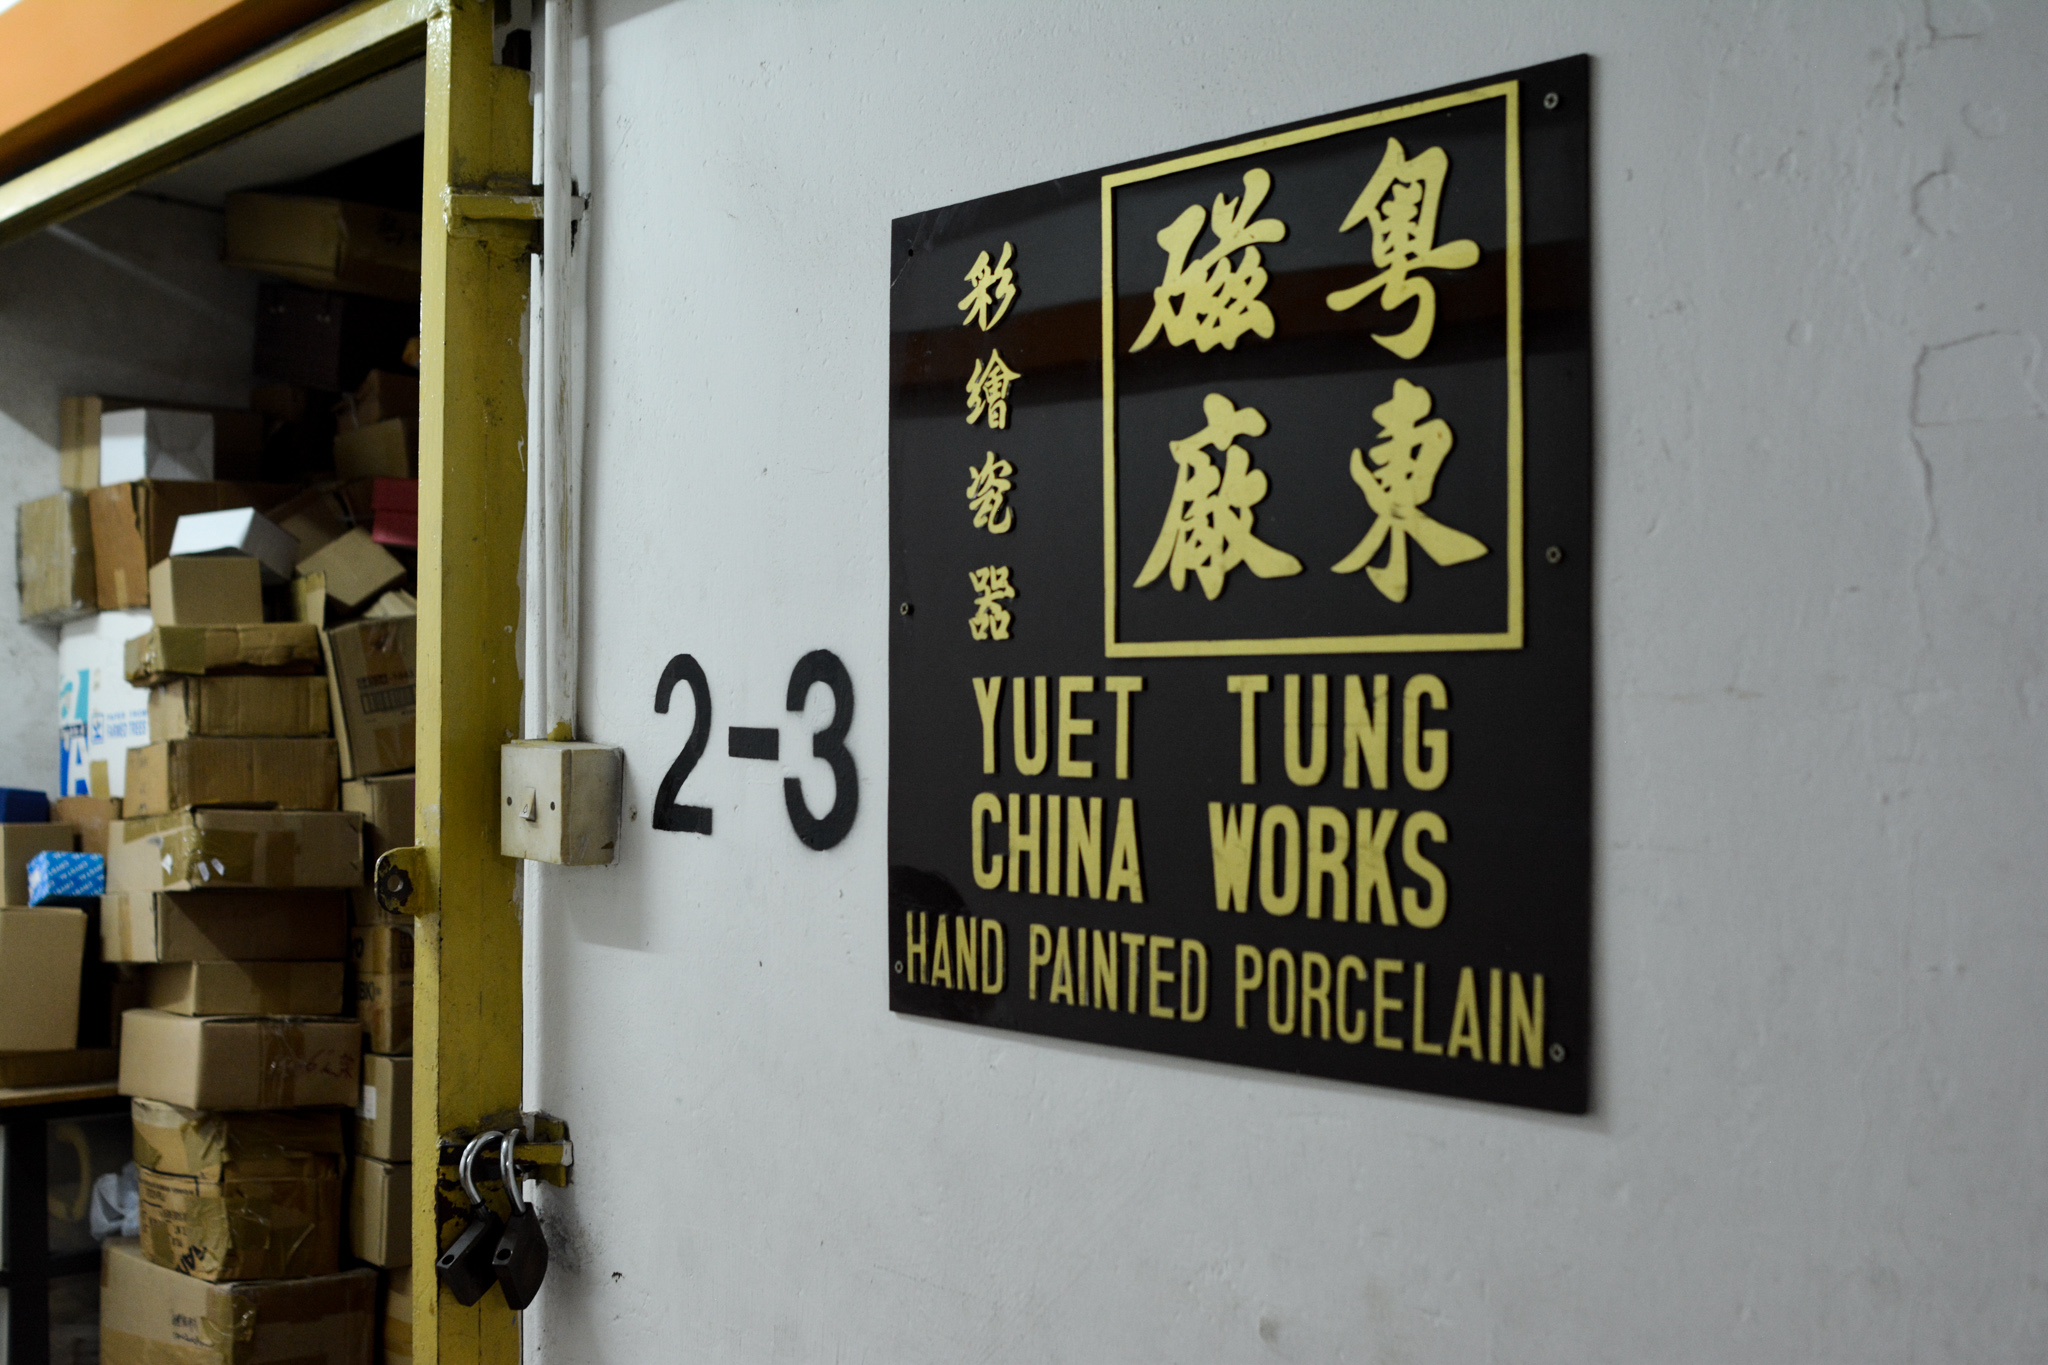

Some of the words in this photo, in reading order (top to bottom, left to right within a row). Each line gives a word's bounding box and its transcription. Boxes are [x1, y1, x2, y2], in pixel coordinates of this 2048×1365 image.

[652, 649, 859, 852] 2-3
[972, 675, 1143, 780] YUET
[1227, 673, 1448, 791] TUNG
[971, 792, 1143, 903] CHINA
[1208, 801, 1448, 928] WORKS
[906, 911, 1004, 994] HAND
[1029, 923, 1207, 1022] PAINTED
[1235, 944, 1544, 1068] PORCELAIN
